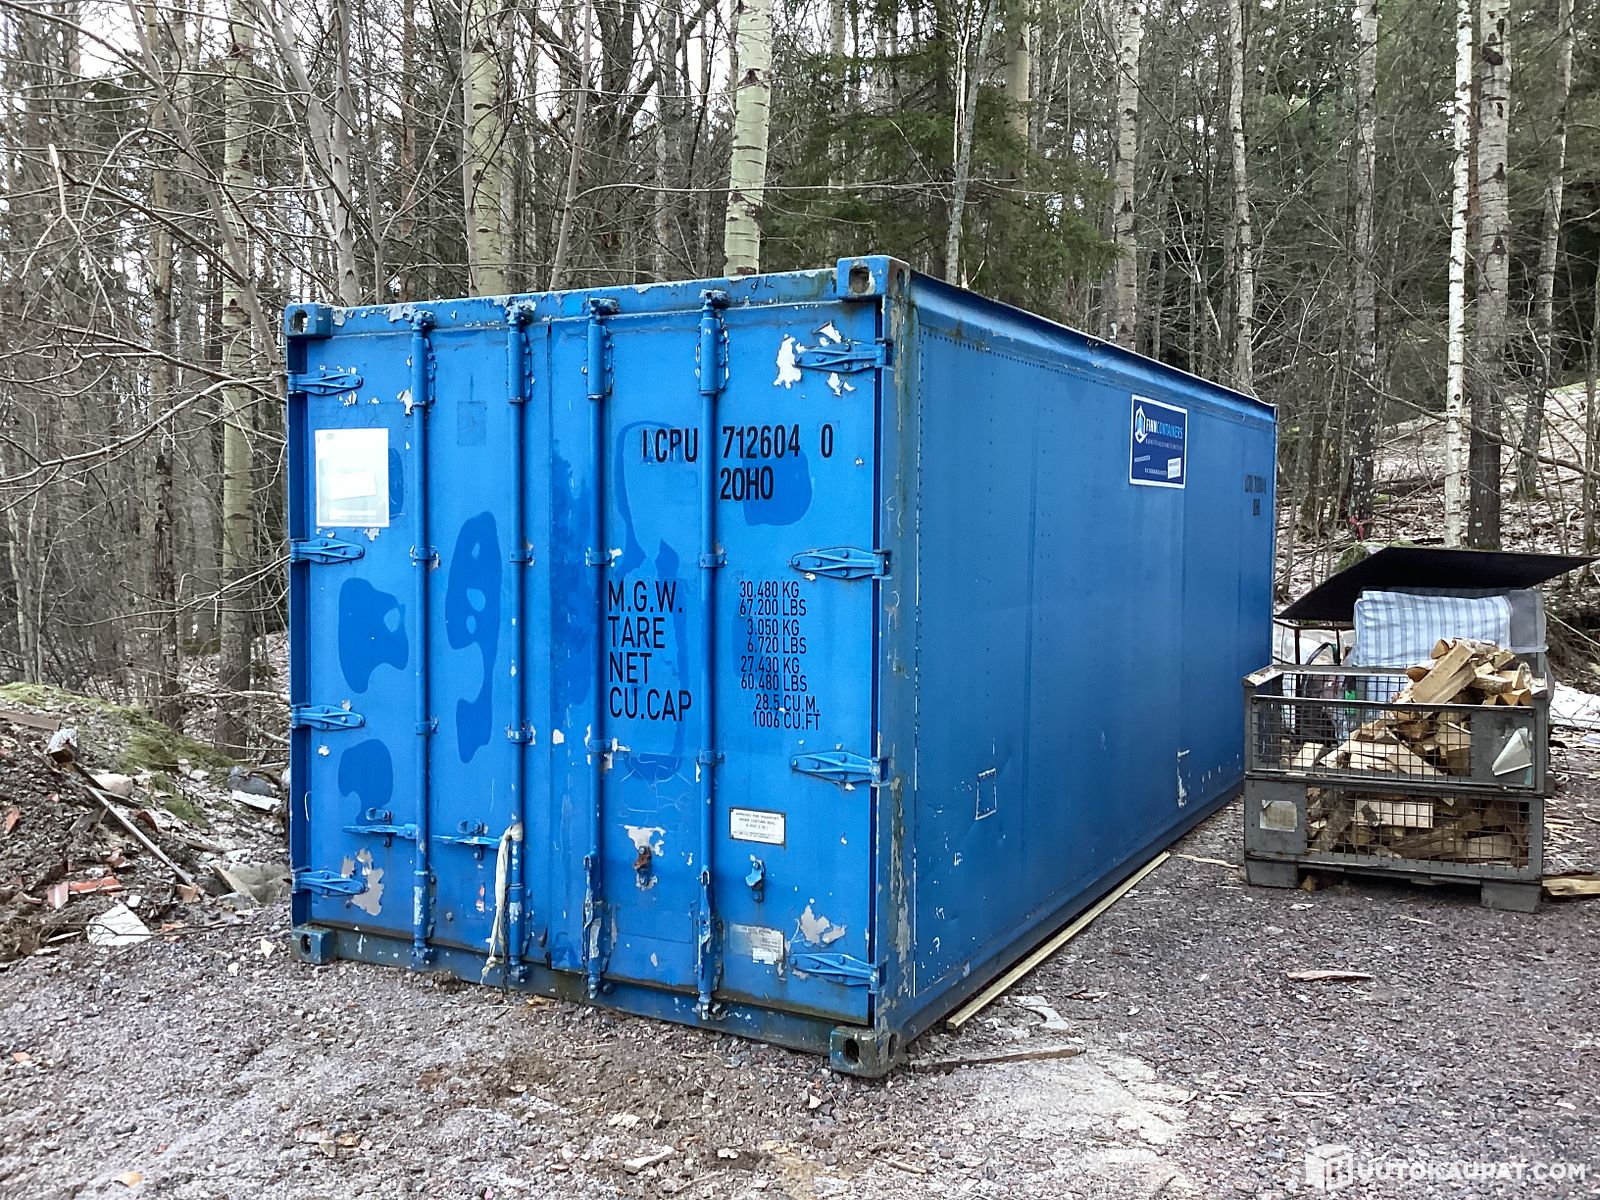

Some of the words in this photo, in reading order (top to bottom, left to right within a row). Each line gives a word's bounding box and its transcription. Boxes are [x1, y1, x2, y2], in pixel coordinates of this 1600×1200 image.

[723, 424, 800, 459] 712604
[608, 580, 683, 613] M.G.W.
[740, 581, 778, 598] 30.480
[782, 581, 799, 598] KG
[740, 598, 779, 616] 67.200
[782, 598, 807, 616] LBS
[608, 616, 665, 649] TARE
[746, 618, 779, 636] 3.050
[782, 619, 800, 637] KG
[747, 636, 779, 653] 6.720
[782, 637, 807, 654] LBS
[609, 652, 652, 684] NET
[740, 655, 779, 673] 27.430
[783, 656, 800, 674] KG
[741, 673, 779, 691] 60.480
[783, 674, 808, 692] LBS
[609, 687, 692, 721] CU.CAP
[755, 693, 780, 711] 28.5
[783, 694, 820, 713] CU.M.
[753, 711, 780, 728] 1006
[783, 712, 821, 731] CU.FT
